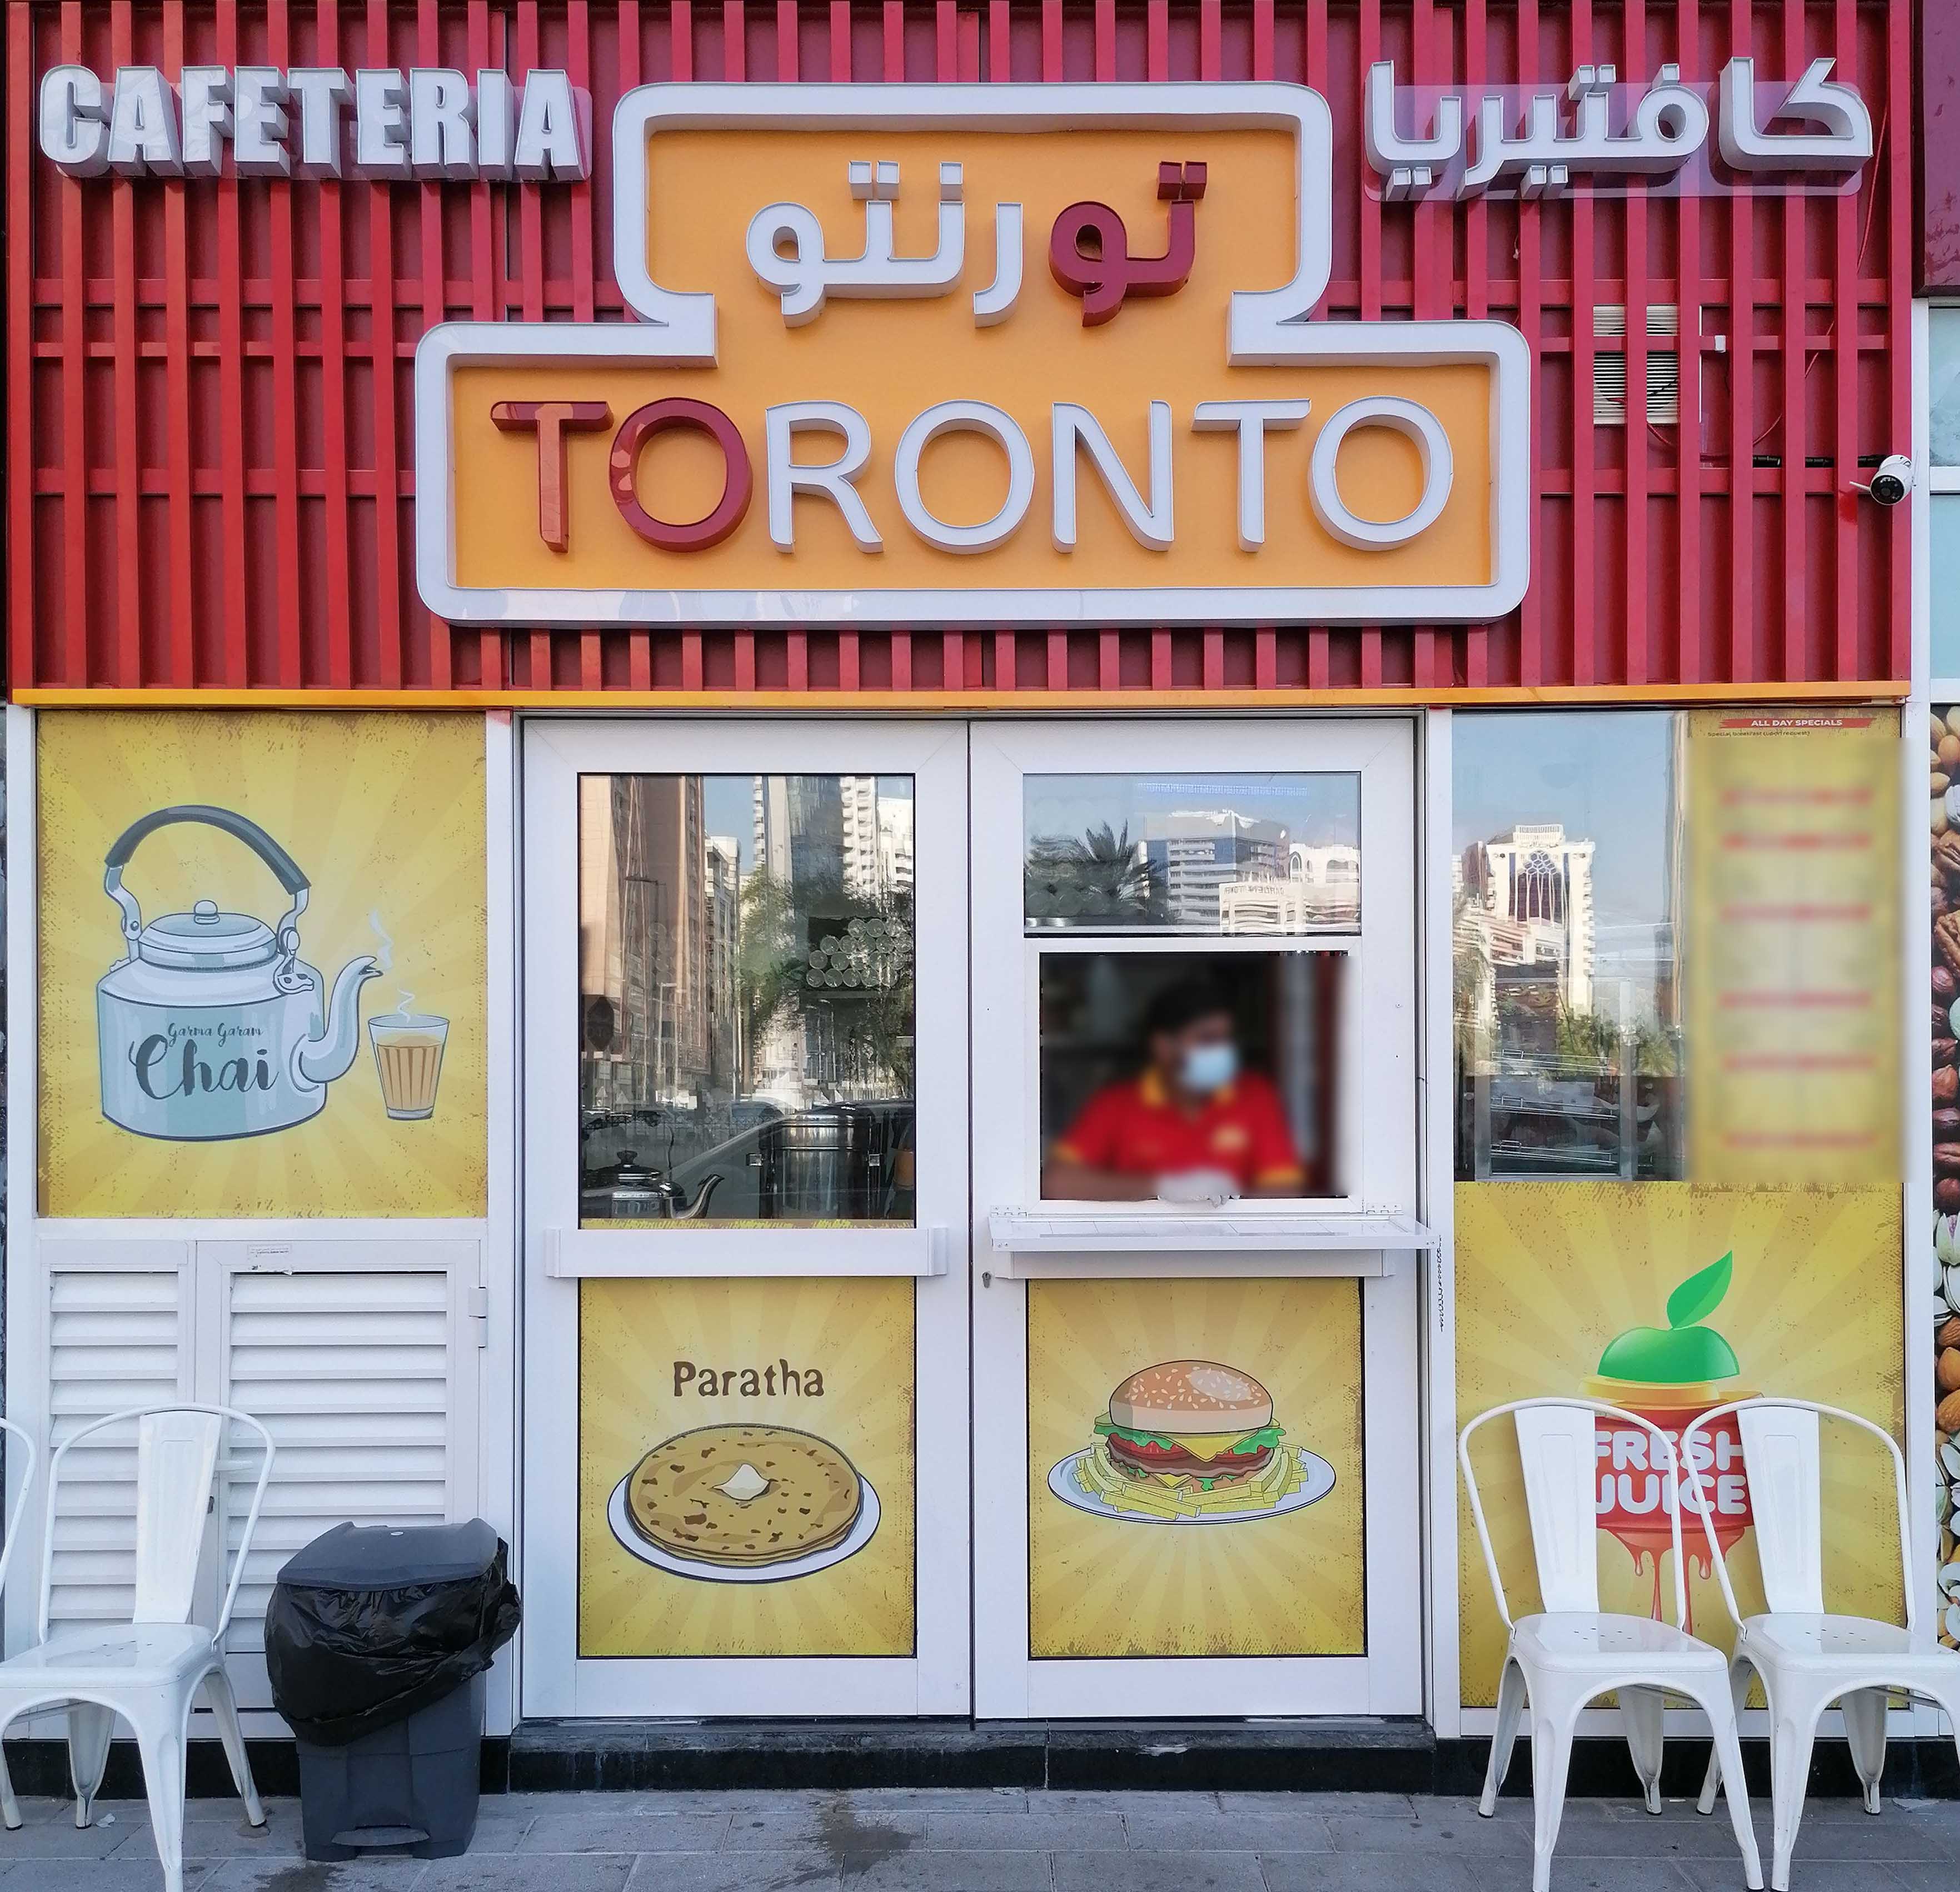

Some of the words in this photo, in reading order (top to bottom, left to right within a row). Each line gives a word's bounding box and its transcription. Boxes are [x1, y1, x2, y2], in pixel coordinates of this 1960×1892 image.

[40, 64, 590, 180] CAFETERIA
[1364, 57, 1873, 201] كافتيريا
[746, 160, 1208, 328] تورنتو
[490, 397, 1455, 552] TORONTO
[128, 1034, 280, 1099] Chai
[217, 1023, 263, 1047] Garam
[674, 1358, 825, 1397] Paratha
